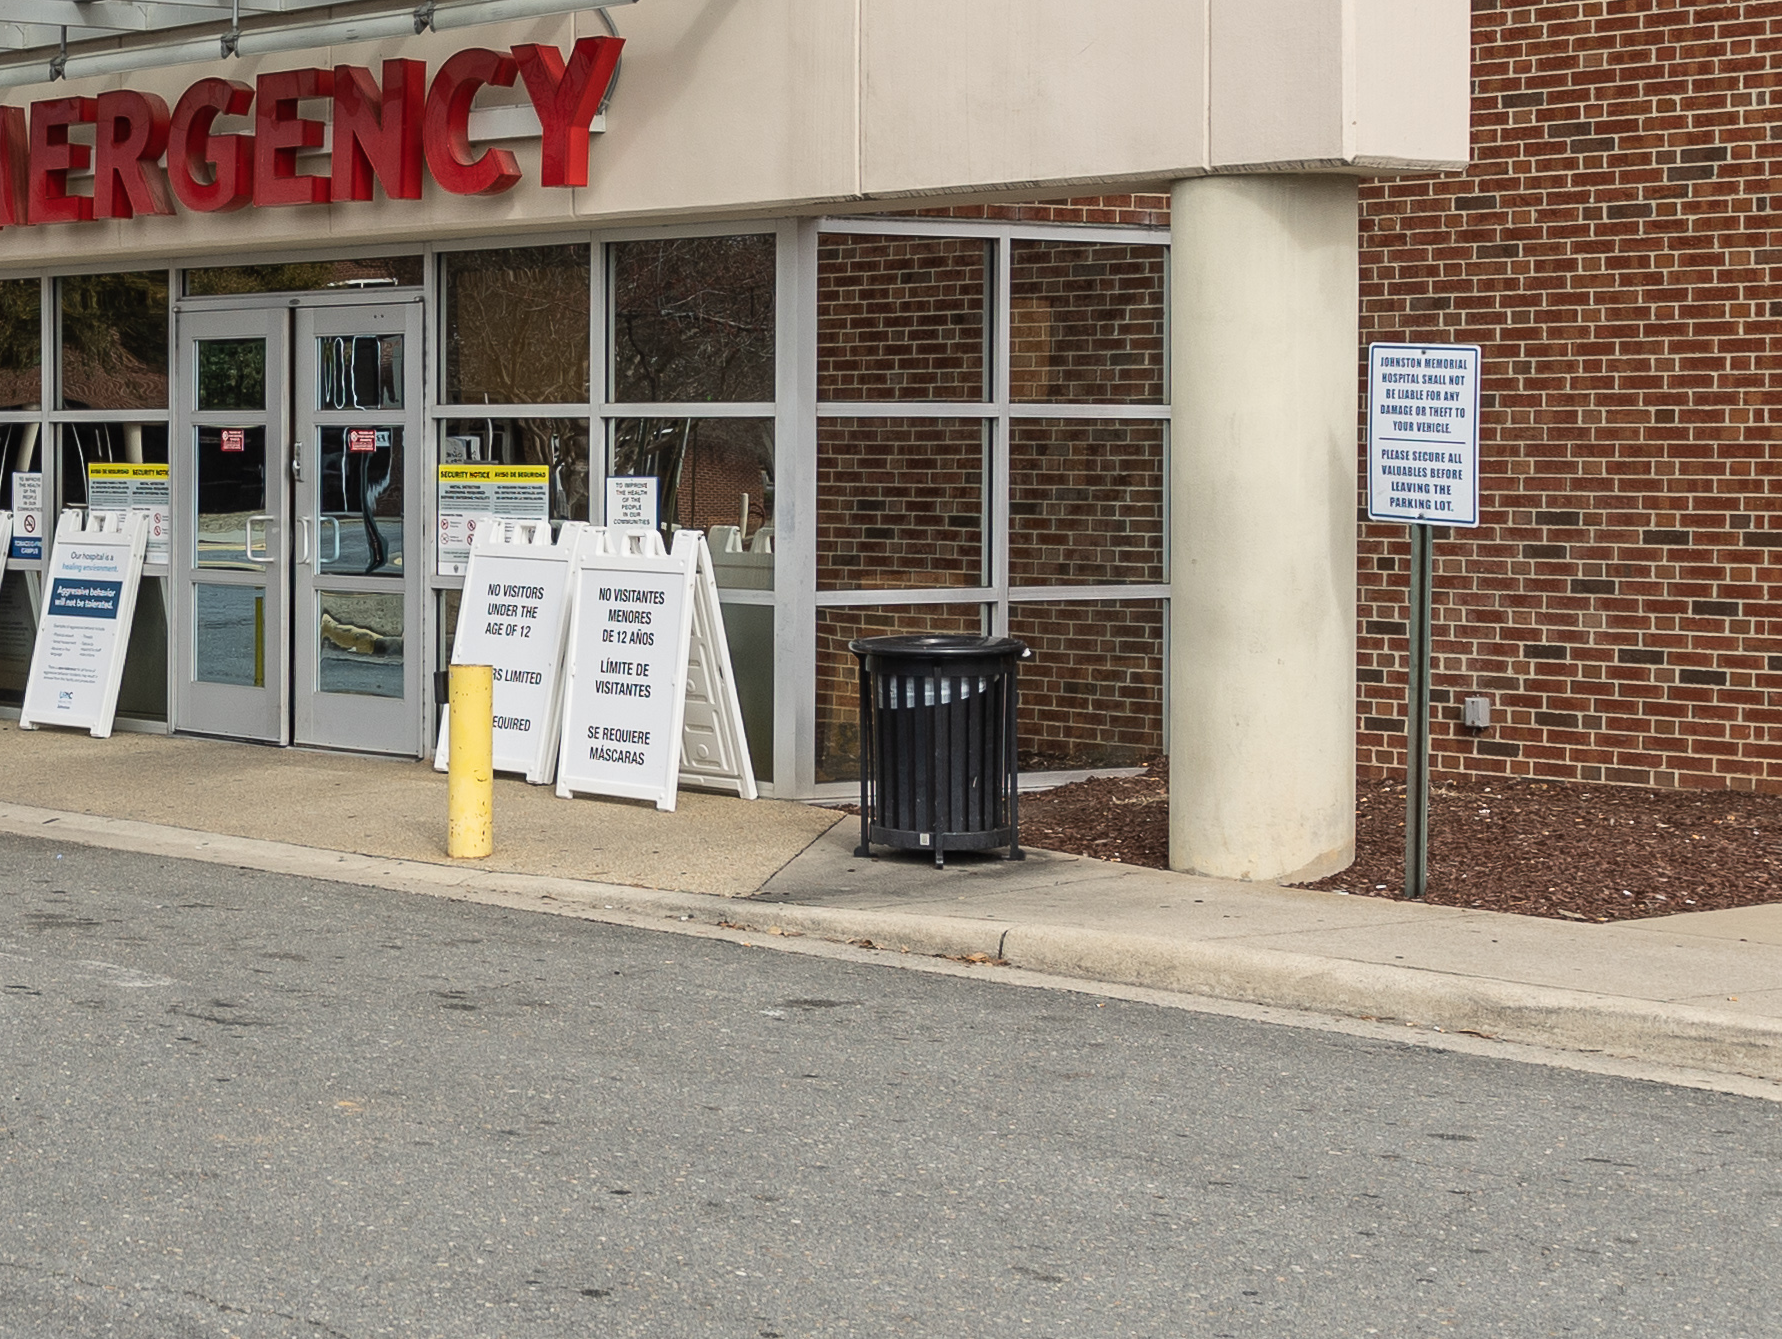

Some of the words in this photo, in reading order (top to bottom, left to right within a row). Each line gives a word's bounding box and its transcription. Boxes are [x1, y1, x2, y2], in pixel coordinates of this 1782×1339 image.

[1380, 357, 1421, 368] JOHNSTON
[1424, 358, 1467, 370] MEMORIAL
[1381, 373, 1420, 384] HOSPITAL
[1422, 374, 1446, 385] SHALL
[1449, 375, 1465, 386] NOT
[1386, 389, 1396, 399] BE
[1398, 389, 1423, 400] LIABLE
[1426, 390, 1441, 400] FOR
[1444, 391, 1460, 402] ANY
[1380, 405, 1413, 416] DAMAGE
[1415, 406, 1426, 416] OR
[1429, 407, 1453, 418] THEFT
[1455, 408, 1465, 418] TO
[1393, 421, 1414, 432] YOUR
[1416, 422, 1451, 434] VEHICLE.
[1381, 449, 1410, 460] PLEASE
[1412, 451, 1445, 463] SECURE
[1448, 453, 1462, 464] ALL
[440, 471, 468, 479] SECURITY
[470, 471, 490, 479] NOTICE
[1381, 465, 1427, 478] VALUABLES
[1430, 468, 1462, 480] BEFORE
[1391, 481, 1430, 494] LEAVING
[1433, 484, 1451, 495] THE
[1389, 497, 1431, 510] PARKING
[1434, 501, 1454, 512] LOT.
[71, 551, 82, 559] Our
[82, 552, 104, 562] hospital
[62, 563, 83, 572] healing
[57, 585, 89, 596] Aggressive
[89, 587, 115, 597] behavior
[488, 583, 501, 596] NO
[503, 585, 544, 600] VISITORS
[599, 587, 611, 601] NO
[614, 588, 665, 605] VISITANTES
[55, 597, 65, 606] will
[66, 599, 76, 607] not
[77, 599, 84, 607] be
[85, 600, 113, 609] tolerated.
[488, 603, 517, 617] UNDER
[521, 606, 538, 618] THE
[608, 609, 652, 625] MENORES
[485, 622, 504, 635] AGE
[505, 623, 518, 637] OF
[520, 625, 531, 638] 12
[602, 629, 614, 642] DE
[617, 630, 627, 643] 12
[629, 629, 654, 646] AÑOS
[600, 657, 633, 675] LÍMITE
[636, 663, 649, 677] DE
[505, 669, 542, 685] LIMITED
[595, 680, 651, 698] VISITANTES
[492, 715, 531, 731] EQUIRED
[587, 726, 600, 739] SE
[602, 727, 650, 745] REQUIERE
[589, 745, 645, 766] MÁSCARAS
